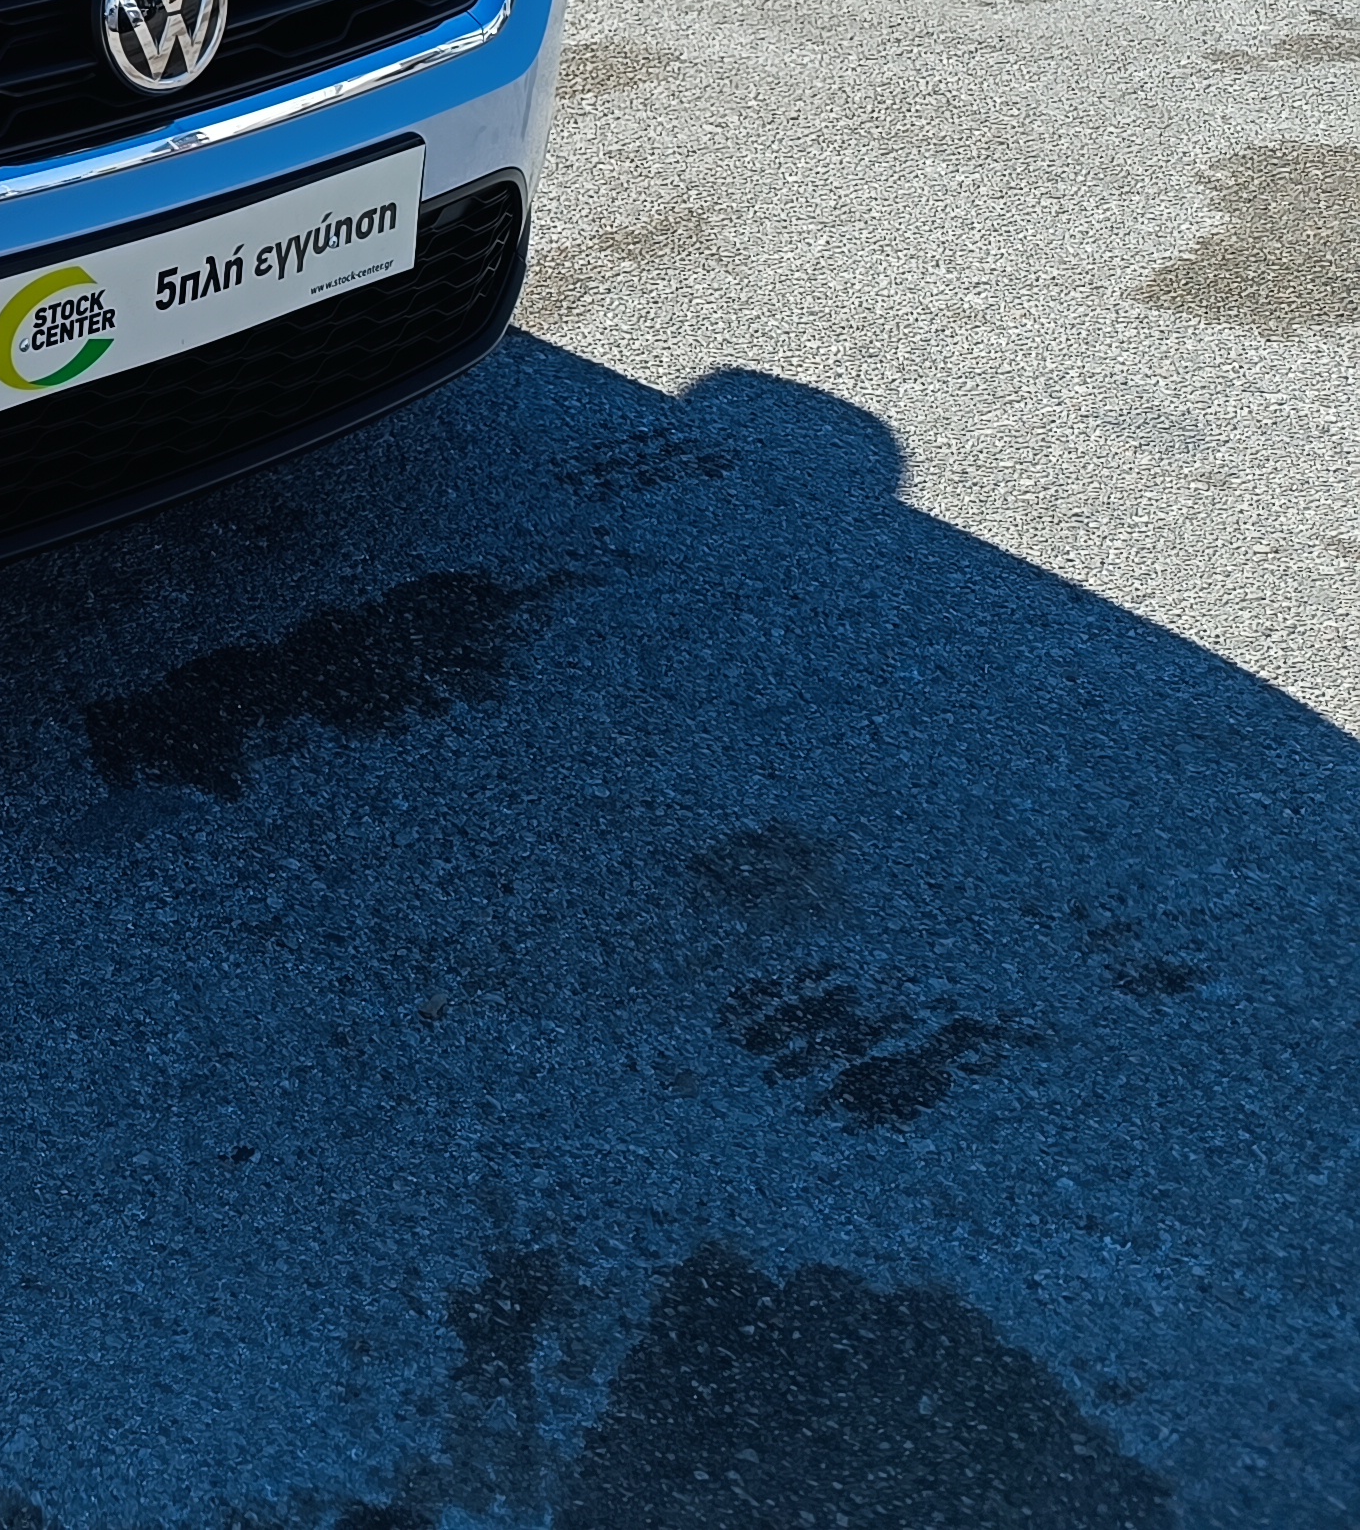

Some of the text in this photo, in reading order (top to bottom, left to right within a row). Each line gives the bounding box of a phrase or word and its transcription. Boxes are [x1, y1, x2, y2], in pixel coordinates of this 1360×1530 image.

[154, 200, 398, 311] 5πλή εγγύηση
[309, 258, 395, 295] www.stock-center.gr
[31, 307, 116, 352] CENTER
[32, 289, 106, 330] STOCK
